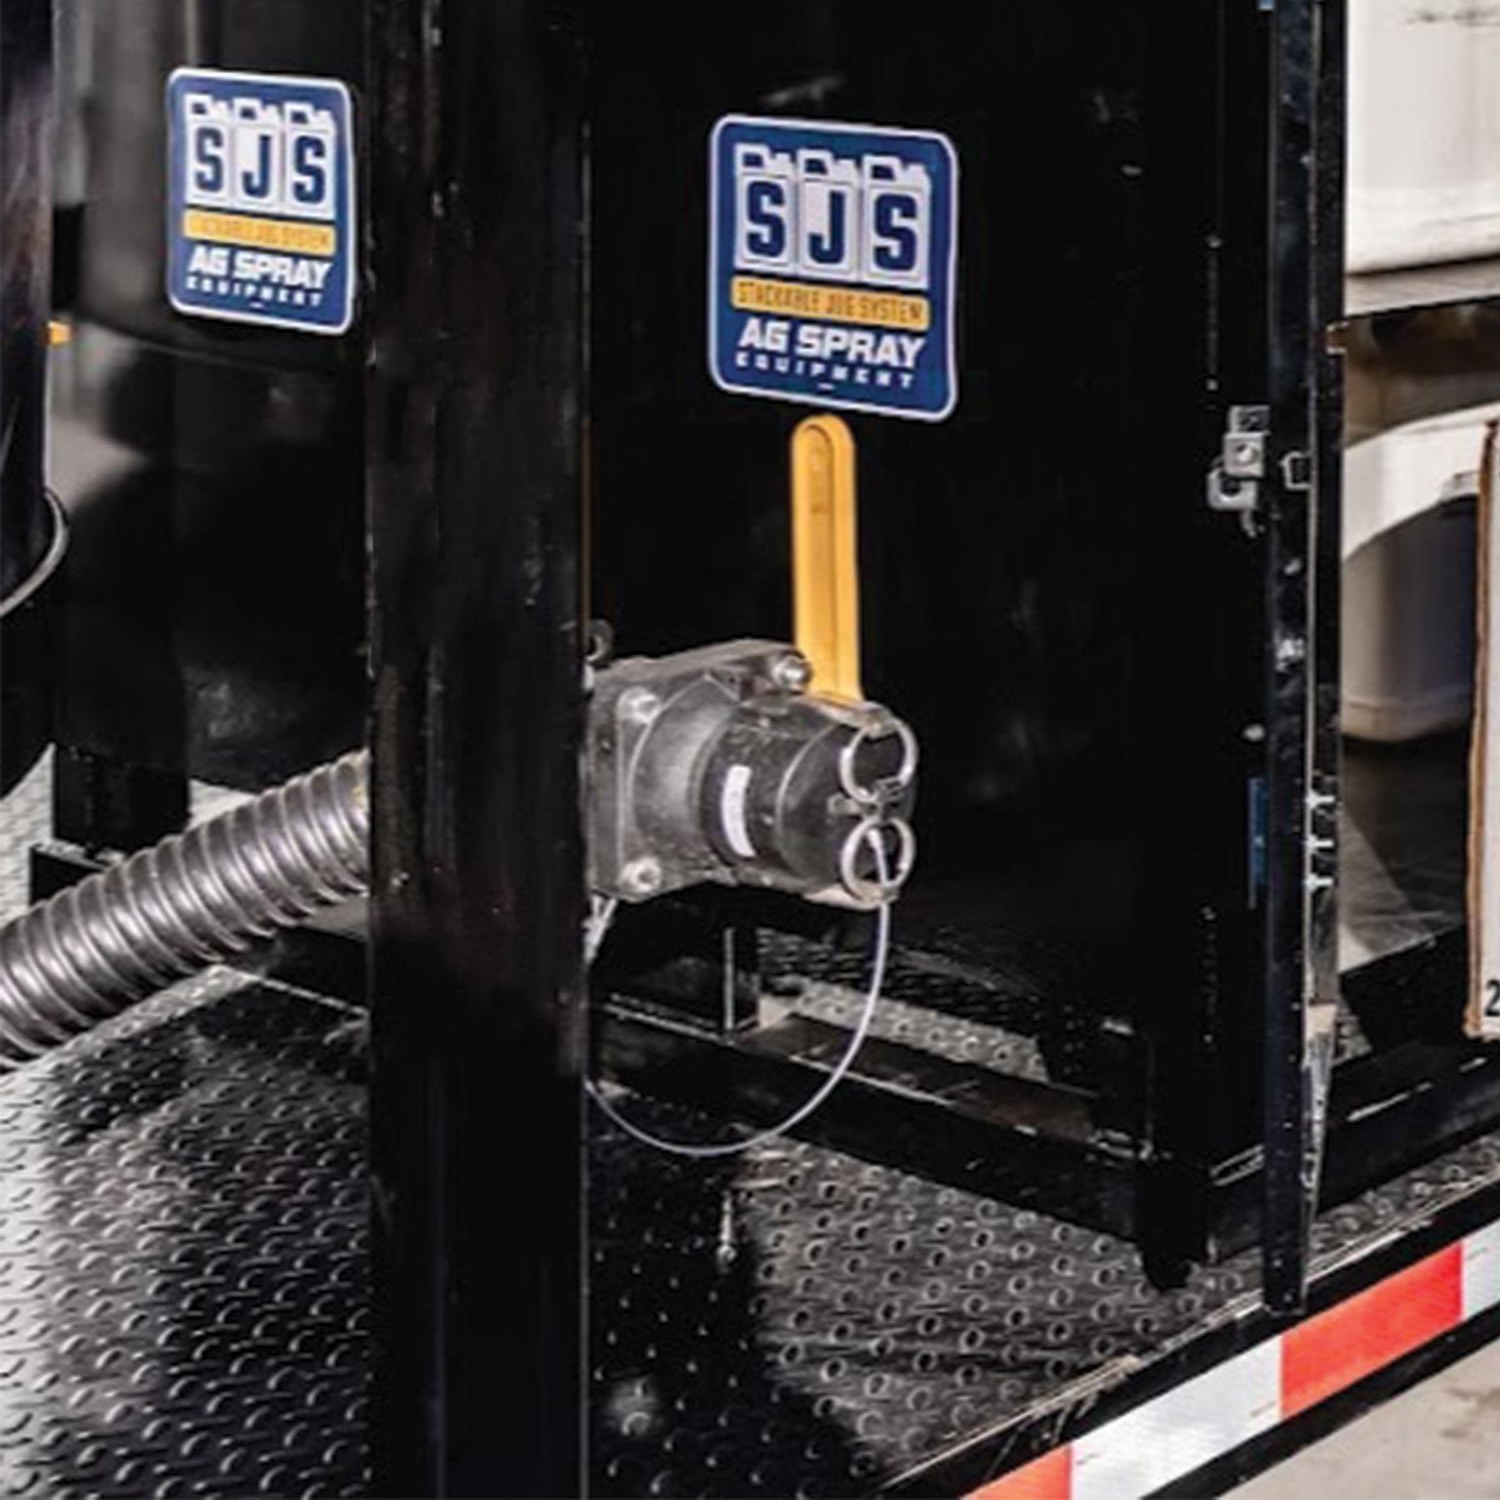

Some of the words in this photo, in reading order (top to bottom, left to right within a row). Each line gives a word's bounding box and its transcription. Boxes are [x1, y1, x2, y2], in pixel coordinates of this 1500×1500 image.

[195, 126, 326, 206] SJS
[746, 180, 918, 272] SJS
[188, 243, 230, 277] AG
[233, 250, 333, 290] SPRAY
[738, 316, 791, 353] AG
[795, 323, 927, 369] SPRAY
[735, 351, 914, 388] EQUIPMENT
